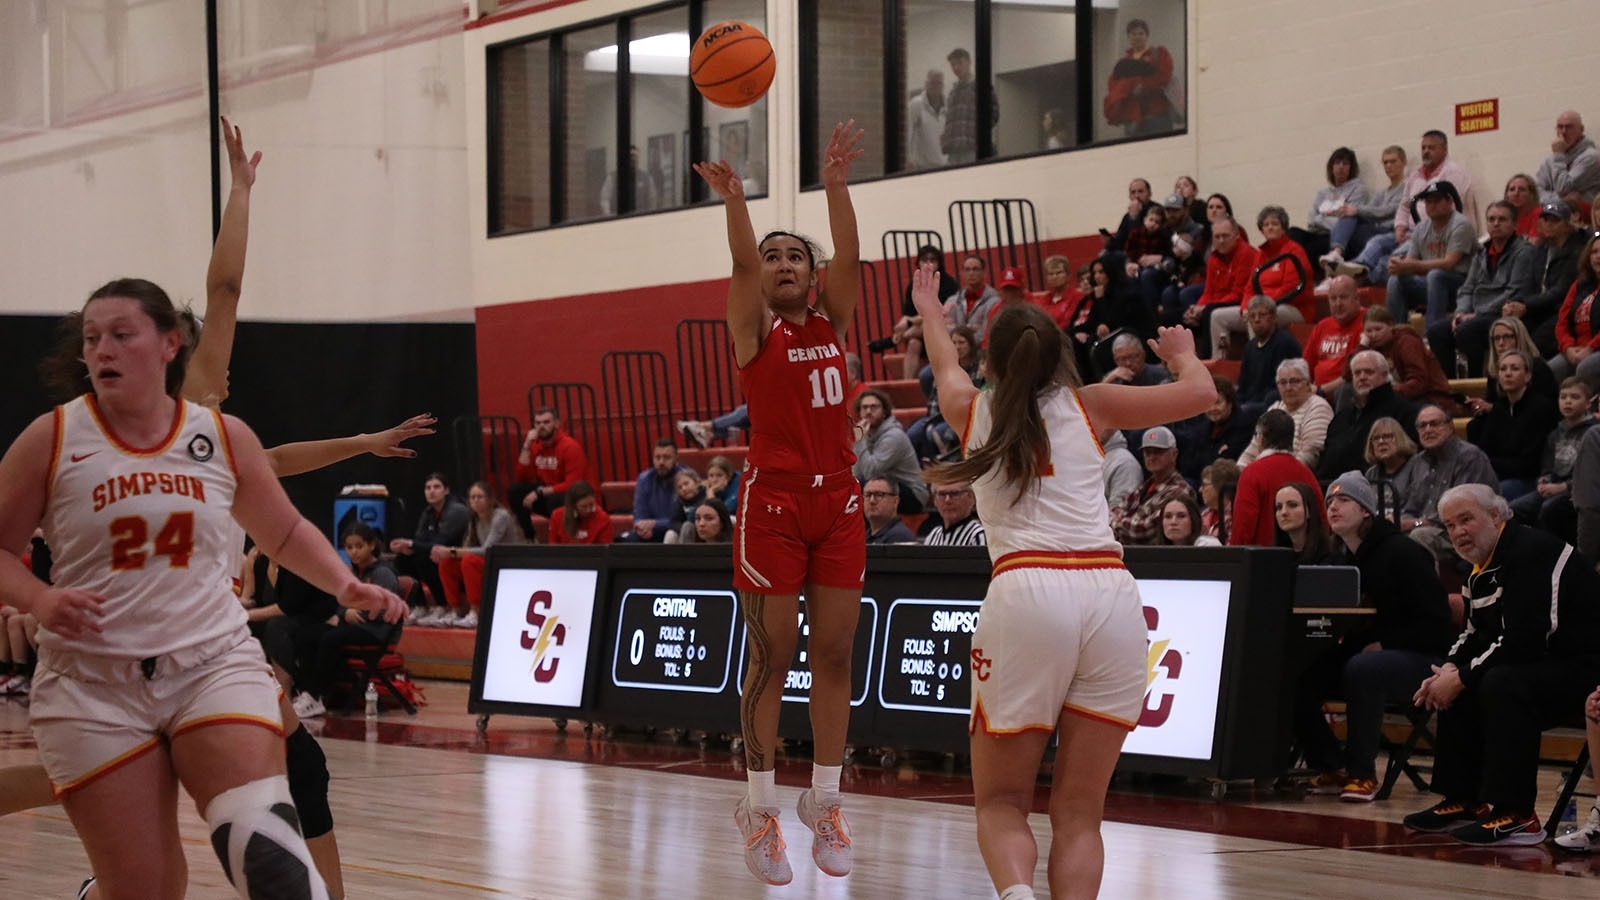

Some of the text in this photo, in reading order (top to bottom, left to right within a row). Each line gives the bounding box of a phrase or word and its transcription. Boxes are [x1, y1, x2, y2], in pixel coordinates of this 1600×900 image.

[703, 24, 743, 48] NCAA
[1460, 101, 1494, 117] VISITOR
[1460, 116, 1494, 132] SEATING
[787, 342, 840, 362] CENTRA
[808, 366, 844, 408] 10
[92, 472, 207, 512] SIMPSON
[108, 510, 195, 572] 24
[653, 597, 698, 618] CENTRAL
[931, 610, 980, 634] SIMPSO
[519, 590, 566, 683] SC
[659, 626, 696, 643] FOULS: 1
[630, 629, 645, 666] 0
[654, 643, 683, 659] BONUS:
[903, 638, 950, 655] FOULS: 1
[664, 661, 692, 678] TOL: 5
[900, 657, 936, 676] BONUS:
[970, 648, 992, 682] SC
[784, 670, 812, 690] RIOD
[910, 679, 945, 701] TOL: 5
